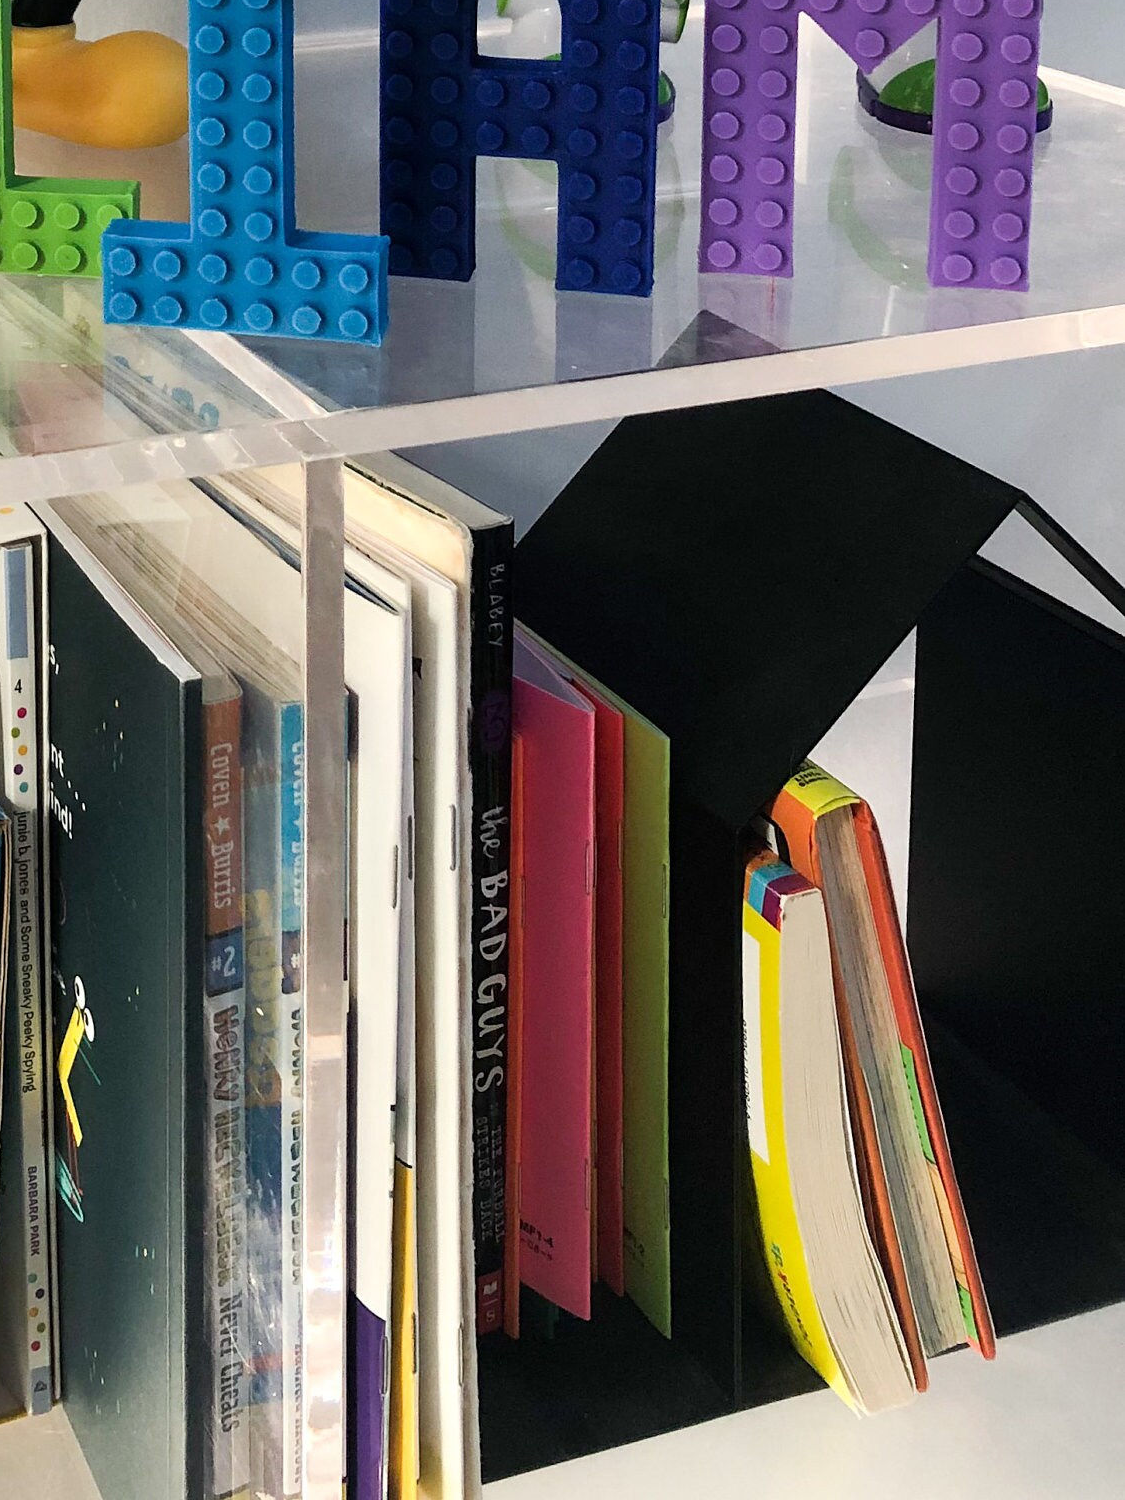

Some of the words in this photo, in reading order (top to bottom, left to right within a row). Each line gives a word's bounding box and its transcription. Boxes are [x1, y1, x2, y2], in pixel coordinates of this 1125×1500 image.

[488, 563, 506, 647] BLABEY
[13, 678, 23, 694] 4
[210, 741, 233, 809] Coven
[13, 810, 31, 842] junie
[480, 804, 509, 859] the
[14, 858, 32, 896] jones
[211, 839, 237, 910] Burris
[20, 899, 33, 924] and
[479, 868, 509, 962] BAD
[20, 925, 33, 963] Some
[210, 945, 236, 978] #2
[21, 962, 34, 1010] Sneaky
[22, 1011, 36, 1050] Peeky
[475, 972, 507, 1094] GUYS
[22, 1049, 37, 1094] Spying
[475, 1115, 492, 1190] STRIKES
[27, 1165, 40, 1223] BARBARA
[491, 1164, 507, 1244] FURBALL
[29, 1224, 41, 1257] PARK
[219, 1289, 244, 1358] Never
[220, 1360, 246, 1434] Cheats
